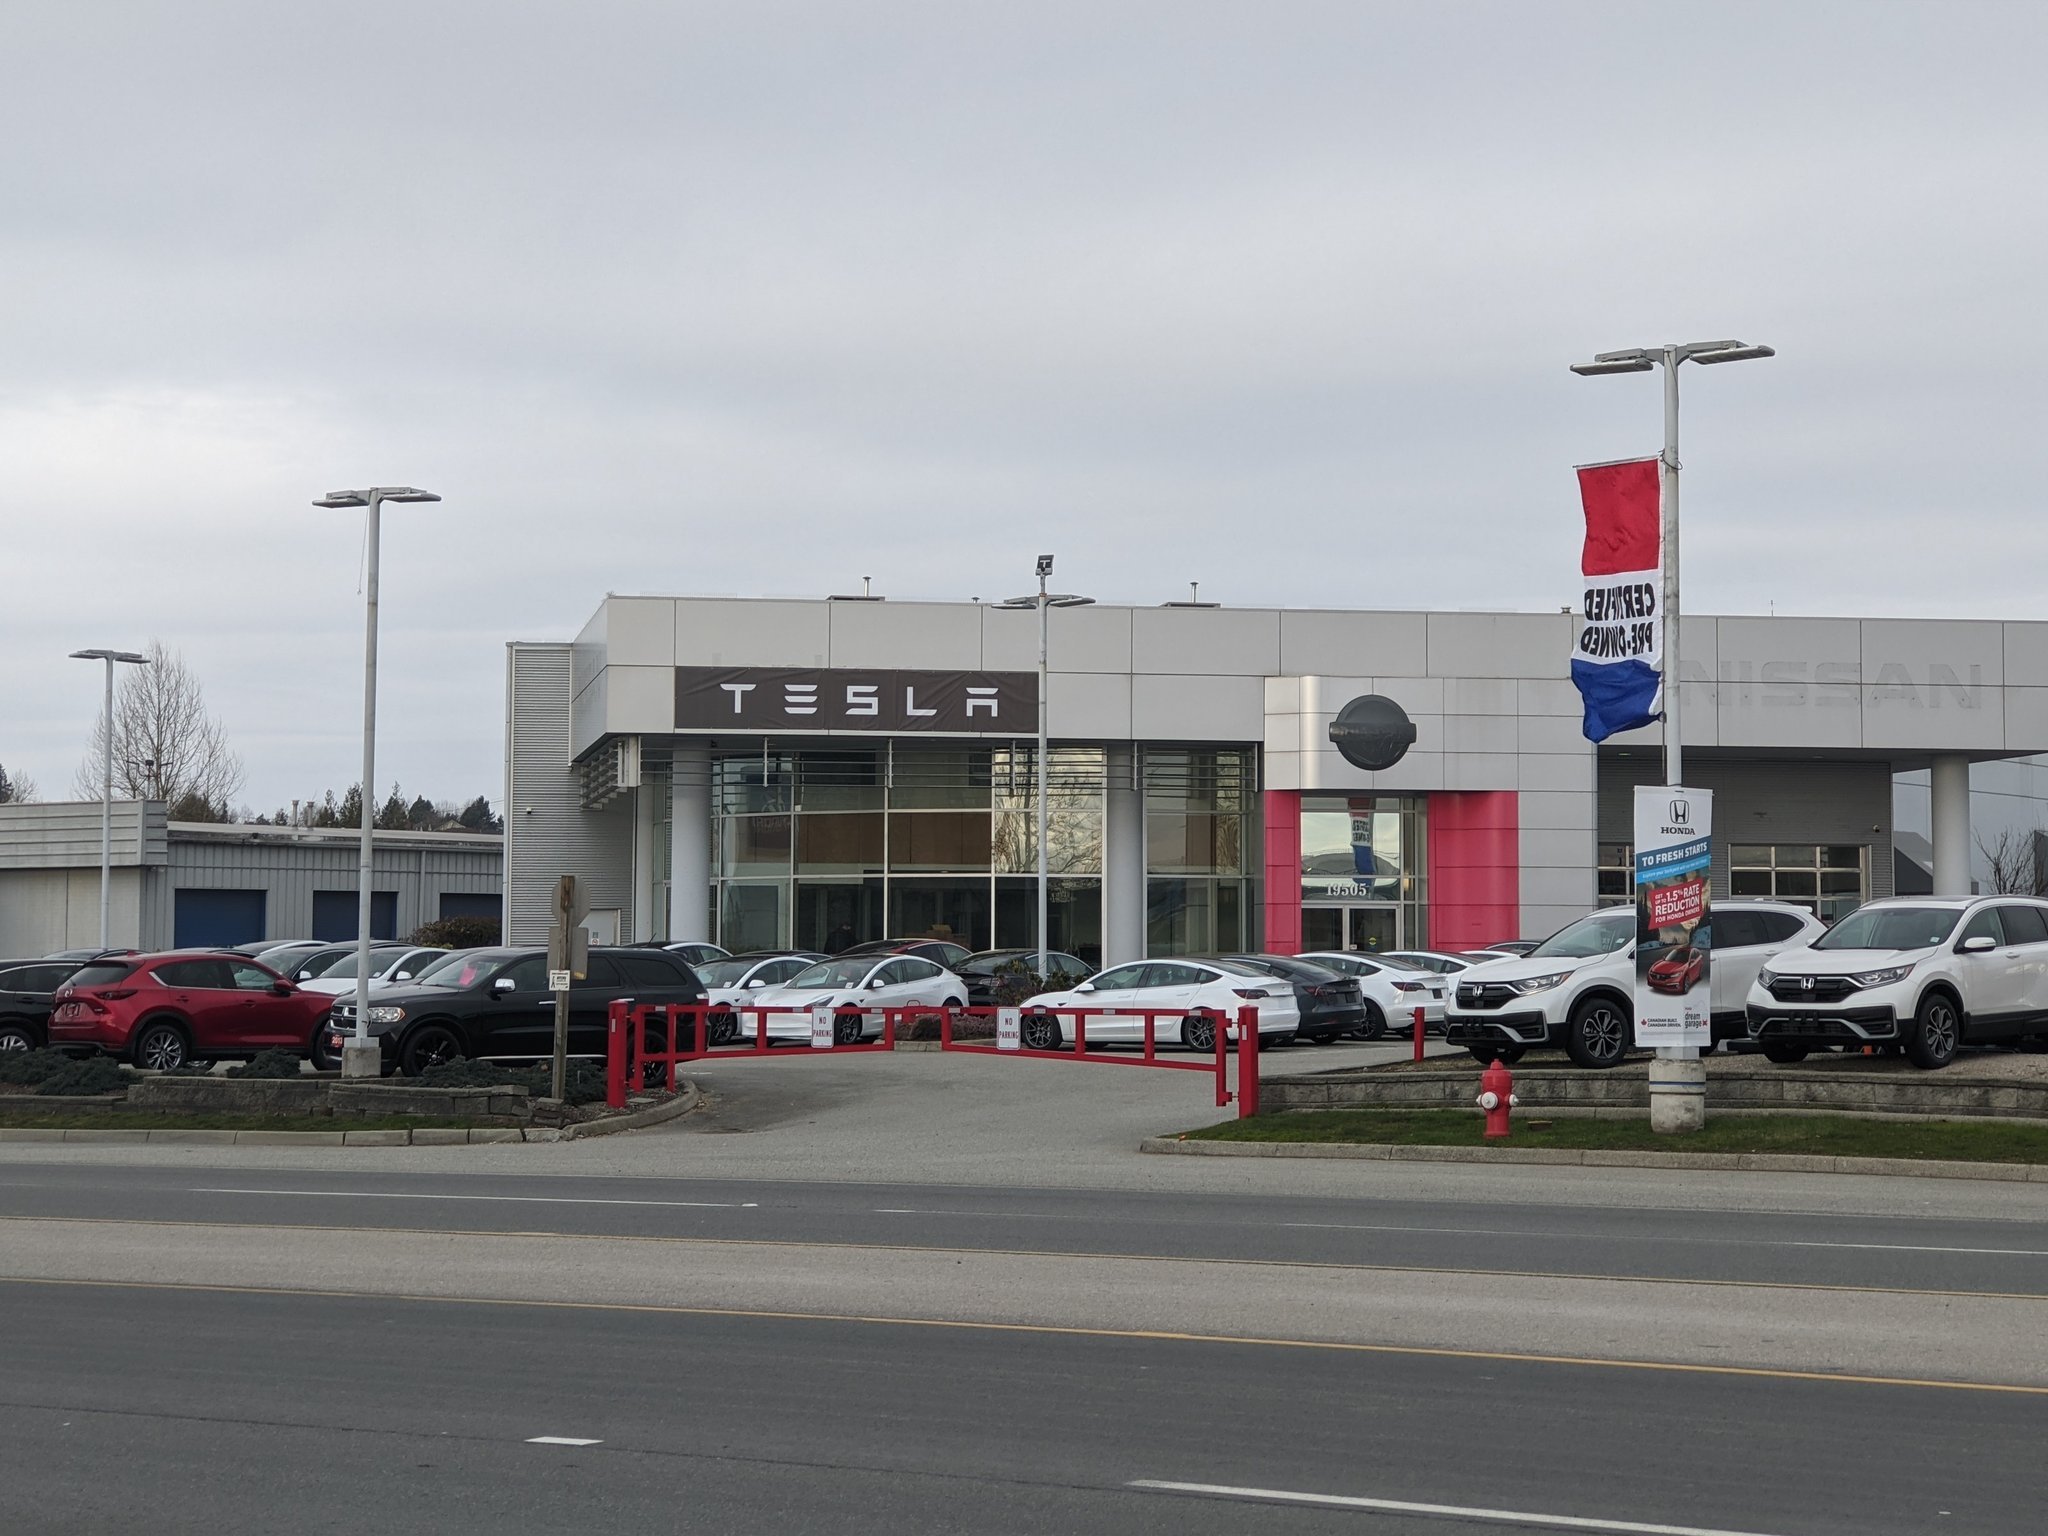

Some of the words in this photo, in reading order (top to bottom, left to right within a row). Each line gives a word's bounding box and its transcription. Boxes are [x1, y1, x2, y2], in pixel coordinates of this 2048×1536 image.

[1680, 660, 1982, 709] NISSAN
[720, 683, 999, 717] TESLA
[1660, 826, 1696, 835] HONDA
[1642, 856, 1654, 867] TO
[1656, 849, 1684, 864] FRESH
[1685, 842, 1708, 857] STARTS
[1325, 882, 1367, 896] 19505
[1683, 883, 1700, 898] RATE
[1655, 894, 1700, 916] REDUCTION
[1667, 911, 1684, 920] HONDA
[819, 1016, 827, 1025] NO
[1004, 1017, 1013, 1026] NO
[812, 1029, 832, 1037] PARKING
[1000, 1030, 1019, 1039] PARKING
